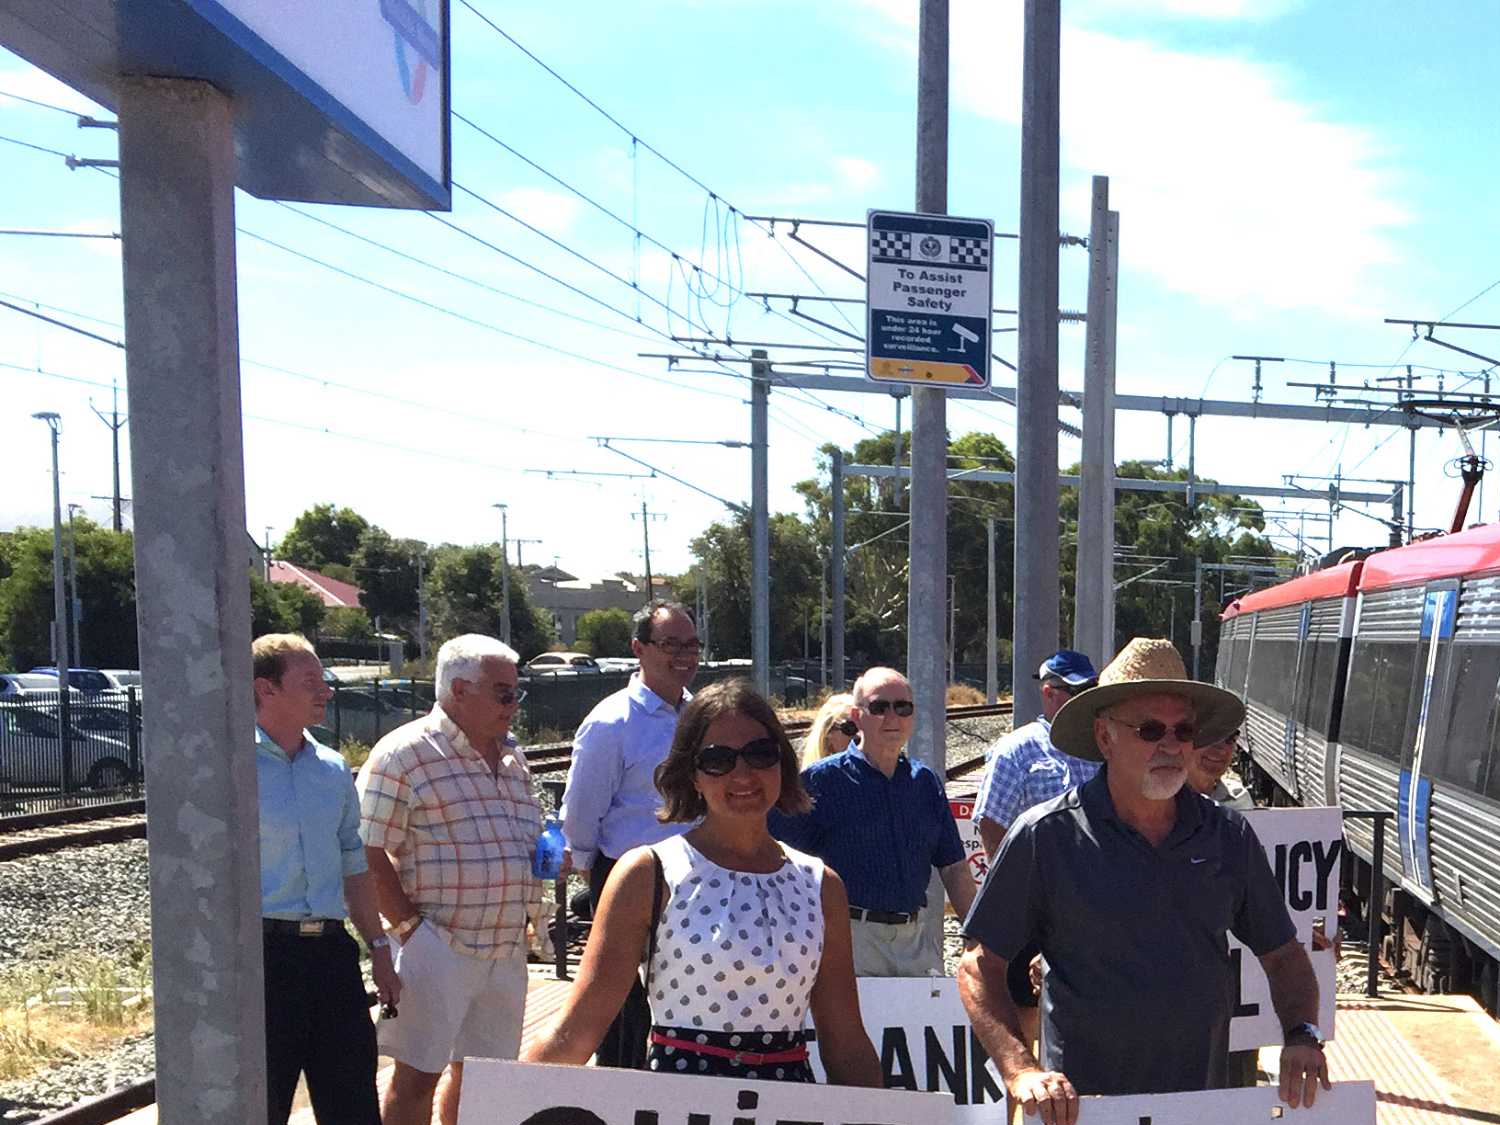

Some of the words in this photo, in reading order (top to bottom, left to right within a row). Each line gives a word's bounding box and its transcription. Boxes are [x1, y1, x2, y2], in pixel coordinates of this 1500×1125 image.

[897, 268, 914, 280] To
[919, 271, 963, 284] Assist
[892, 281, 967, 299] Passenger
[907, 296, 952, 312] Safety
